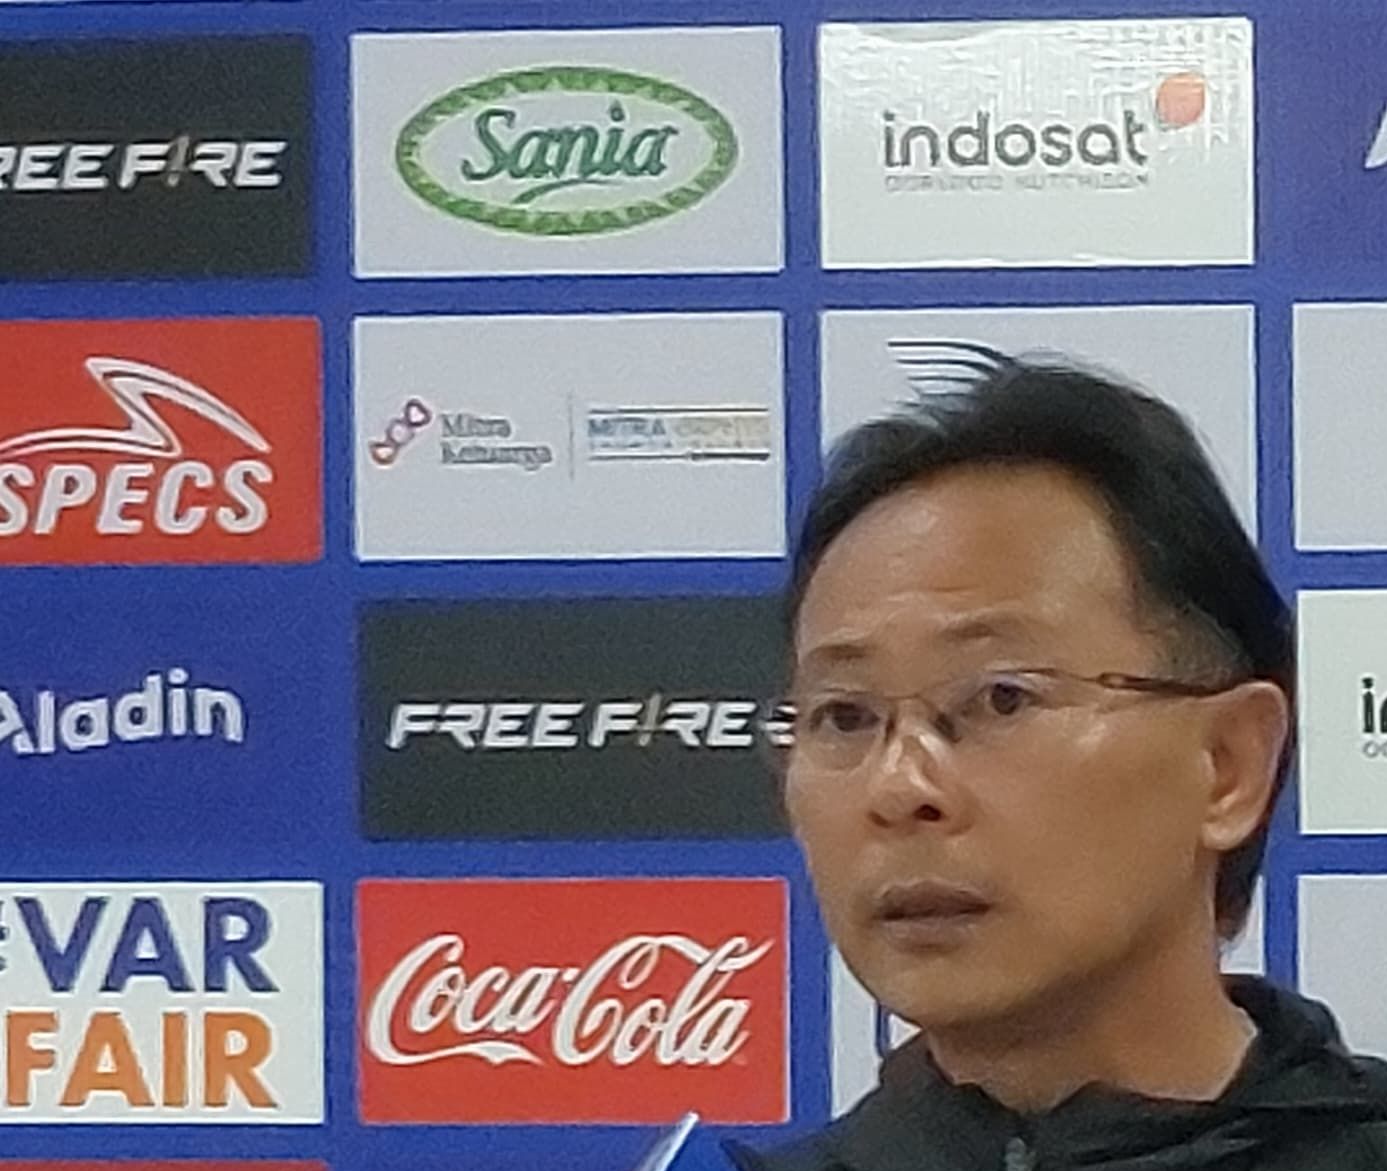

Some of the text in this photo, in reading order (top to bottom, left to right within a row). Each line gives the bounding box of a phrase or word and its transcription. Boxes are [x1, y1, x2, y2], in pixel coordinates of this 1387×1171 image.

[462, 102, 676, 180] Sania
[884, 110, 1148, 167] indosat
[386, 703, 586, 749] FREE
[0, 896, 279, 992] VAR
[6, 1012, 278, 1108] FAIR
